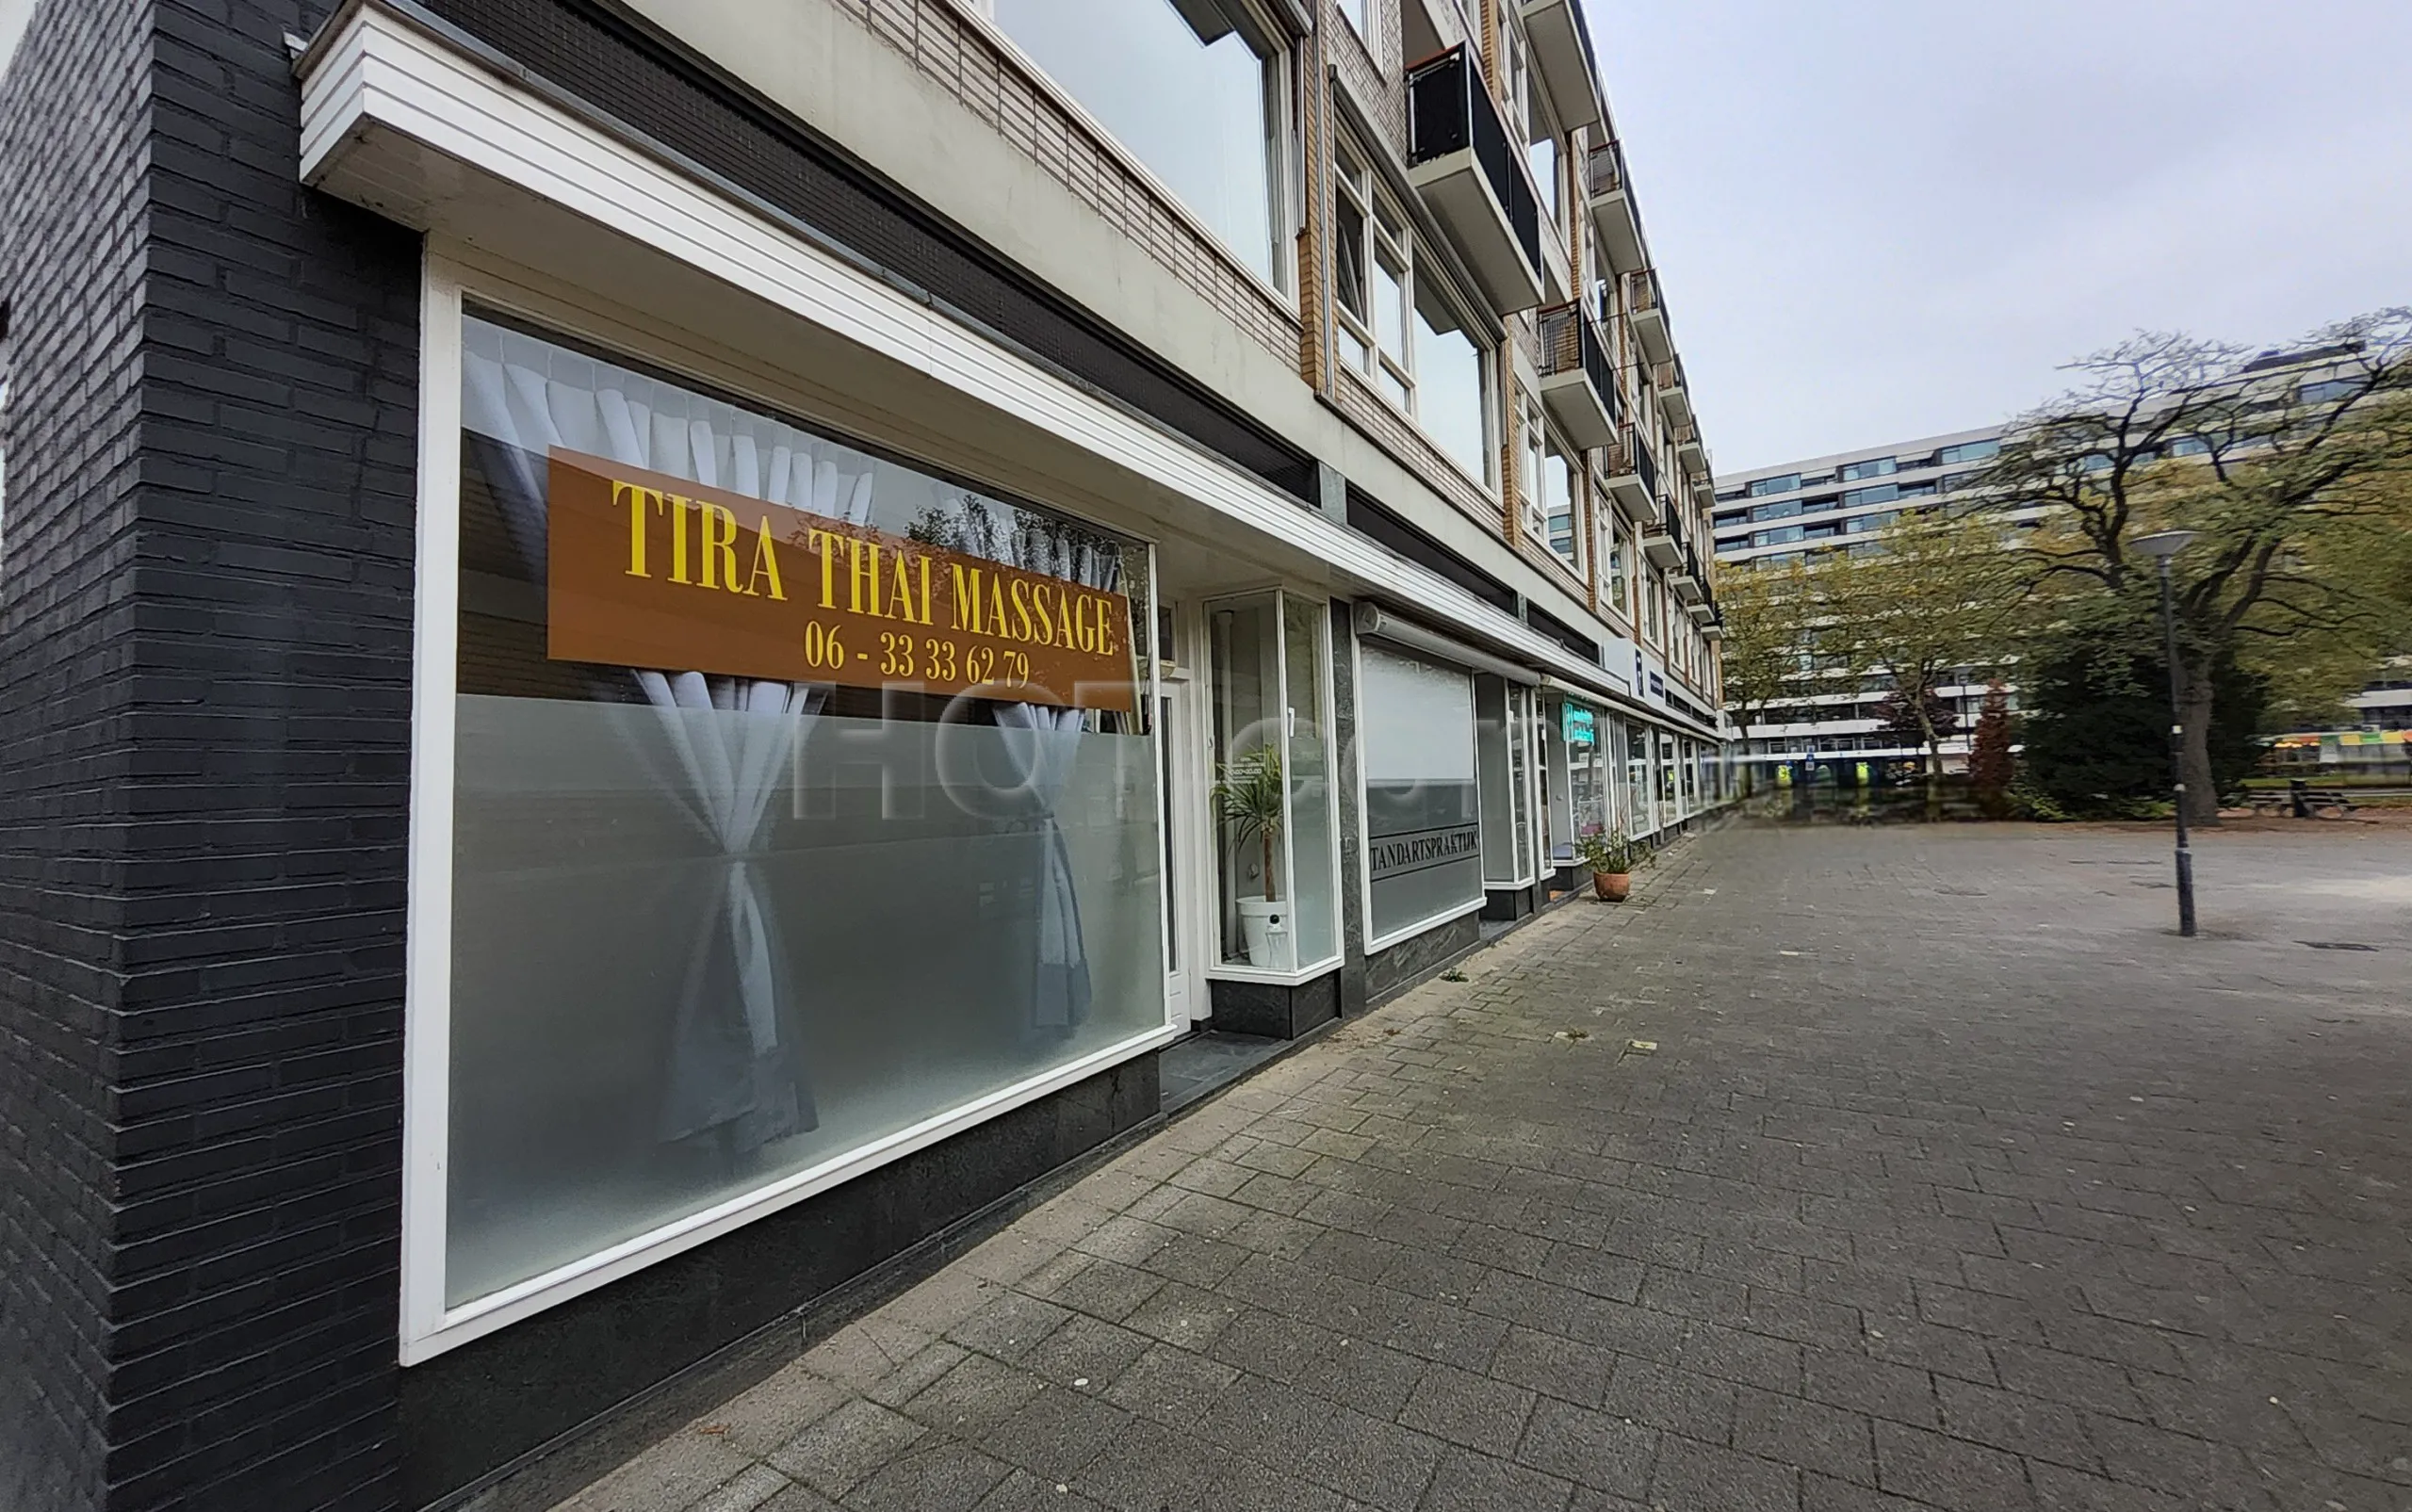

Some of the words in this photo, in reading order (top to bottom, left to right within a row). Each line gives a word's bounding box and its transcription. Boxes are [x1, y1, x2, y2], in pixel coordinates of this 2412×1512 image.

[612, 480, 788, 601] TIRA
[807, 528, 934, 626] THAI
[950, 562, 1115, 657] MASSAGE
[805, 621, 845, 670] 06
[880, 631, 914, 677] 33
[925, 638, 956, 682] 33
[966, 645, 995, 686] 62
[1003, 650, 1030, 689] 79
[1370, 830, 1478, 871] TANDARTSPRAKTIJK
